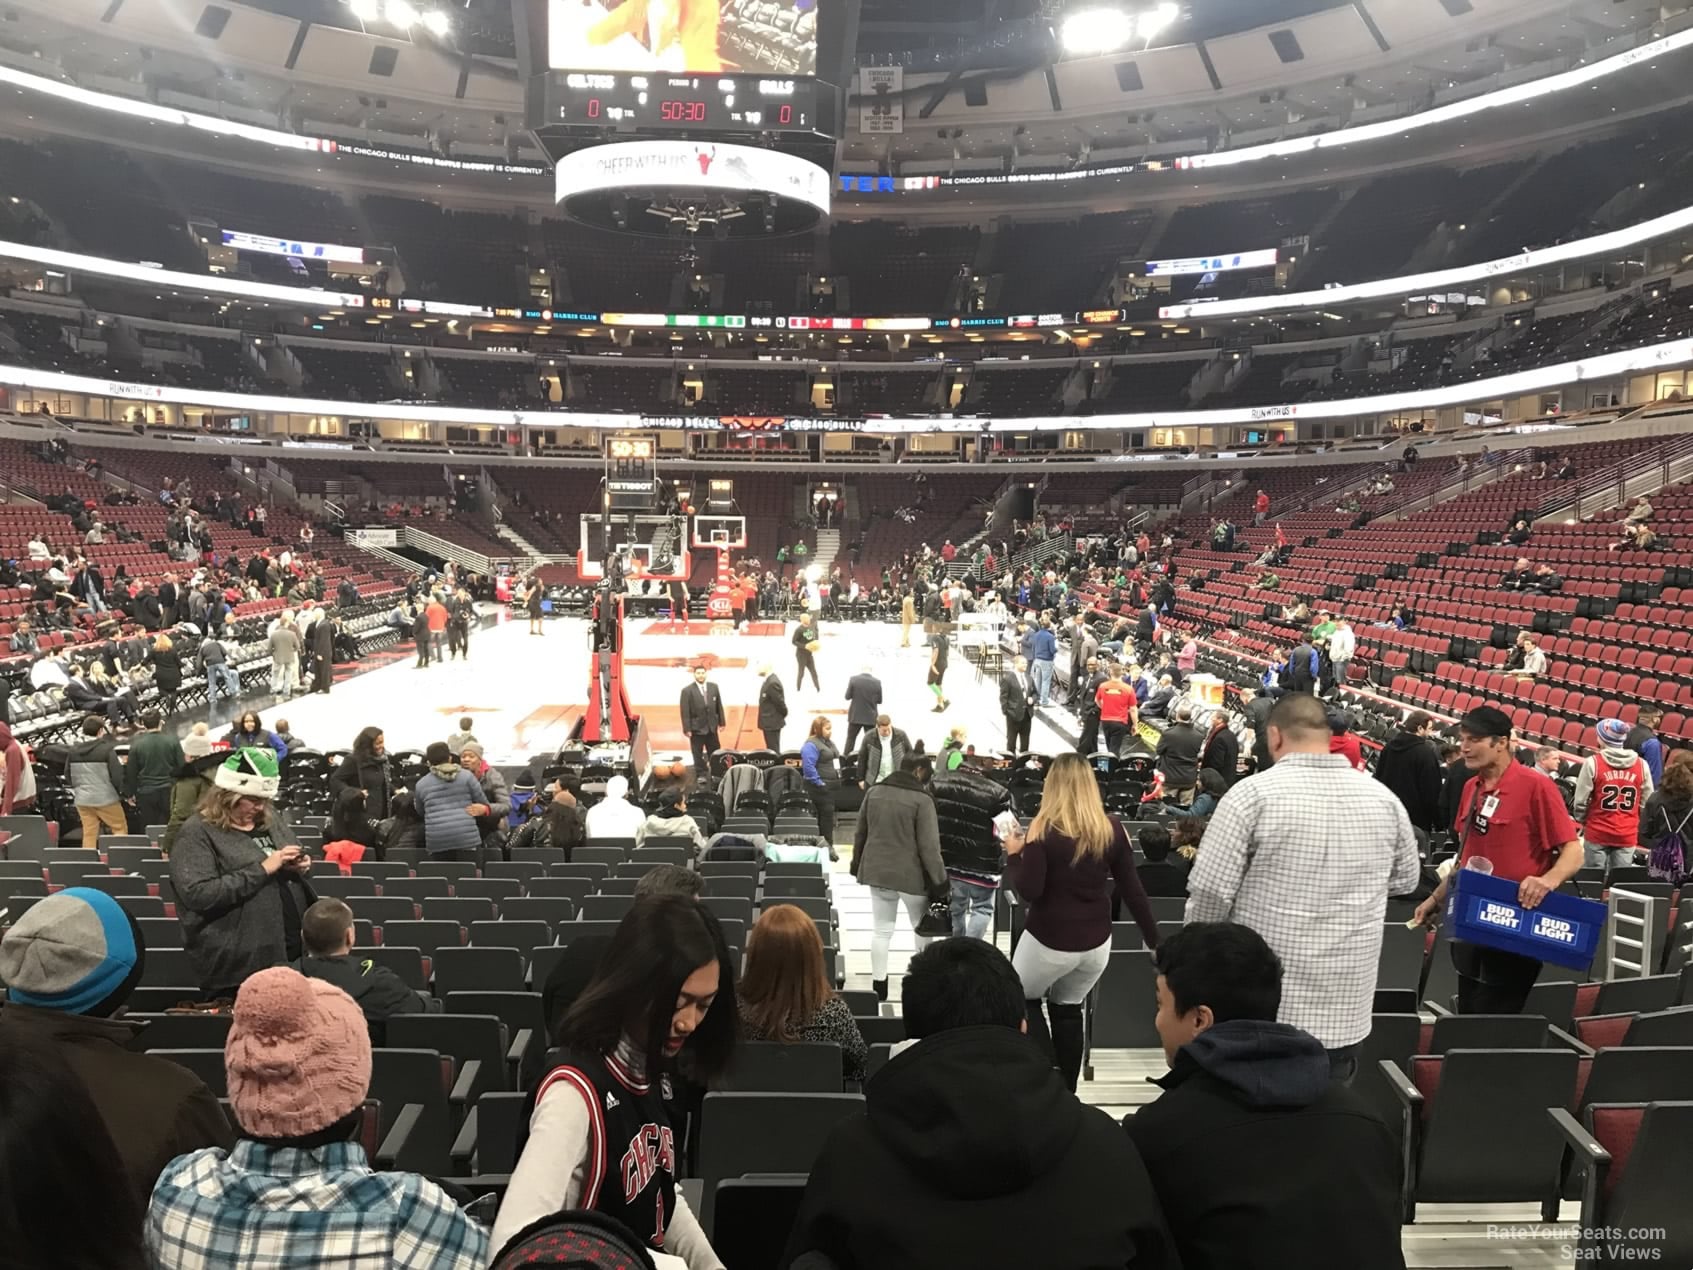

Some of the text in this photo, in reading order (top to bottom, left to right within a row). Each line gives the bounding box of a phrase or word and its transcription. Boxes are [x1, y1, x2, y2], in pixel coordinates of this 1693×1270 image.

[589, 99, 599, 117] 0
[662, 102, 705, 120] 50:30
[780, 105, 791, 123] 0
[338, 144, 352, 152] THE
[353, 147, 387, 158] CHICAGO
[389, 152, 410, 161] BULLS
[505, 165, 543, 174] CURRENTLY
[954, 176, 985, 184] CHICAGO
[986, 175, 1006, 183] BULLS
[1096, 166, 1134, 175] CURRENTLY
[553, 312, 579, 320] HARRIS
[580, 313, 597, 321] CLUB
[961, 319, 984, 327] HARRIS
[986, 318, 1005, 326] CLUB
[1251, 406, 1290, 418] RUN WITH US
[643, 417, 684, 428] CHICAGO
[832, 420, 862, 431] BULLS
[1604, 770, 1637, 782] JORDAN
[1601, 784, 1638, 812] 23
[1484, 903, 1516, 919] BUD
[1479, 911, 1520, 930] LIGHT
[1539, 917, 1571, 933] BUD
[1533, 925, 1575, 943] LIGHT
